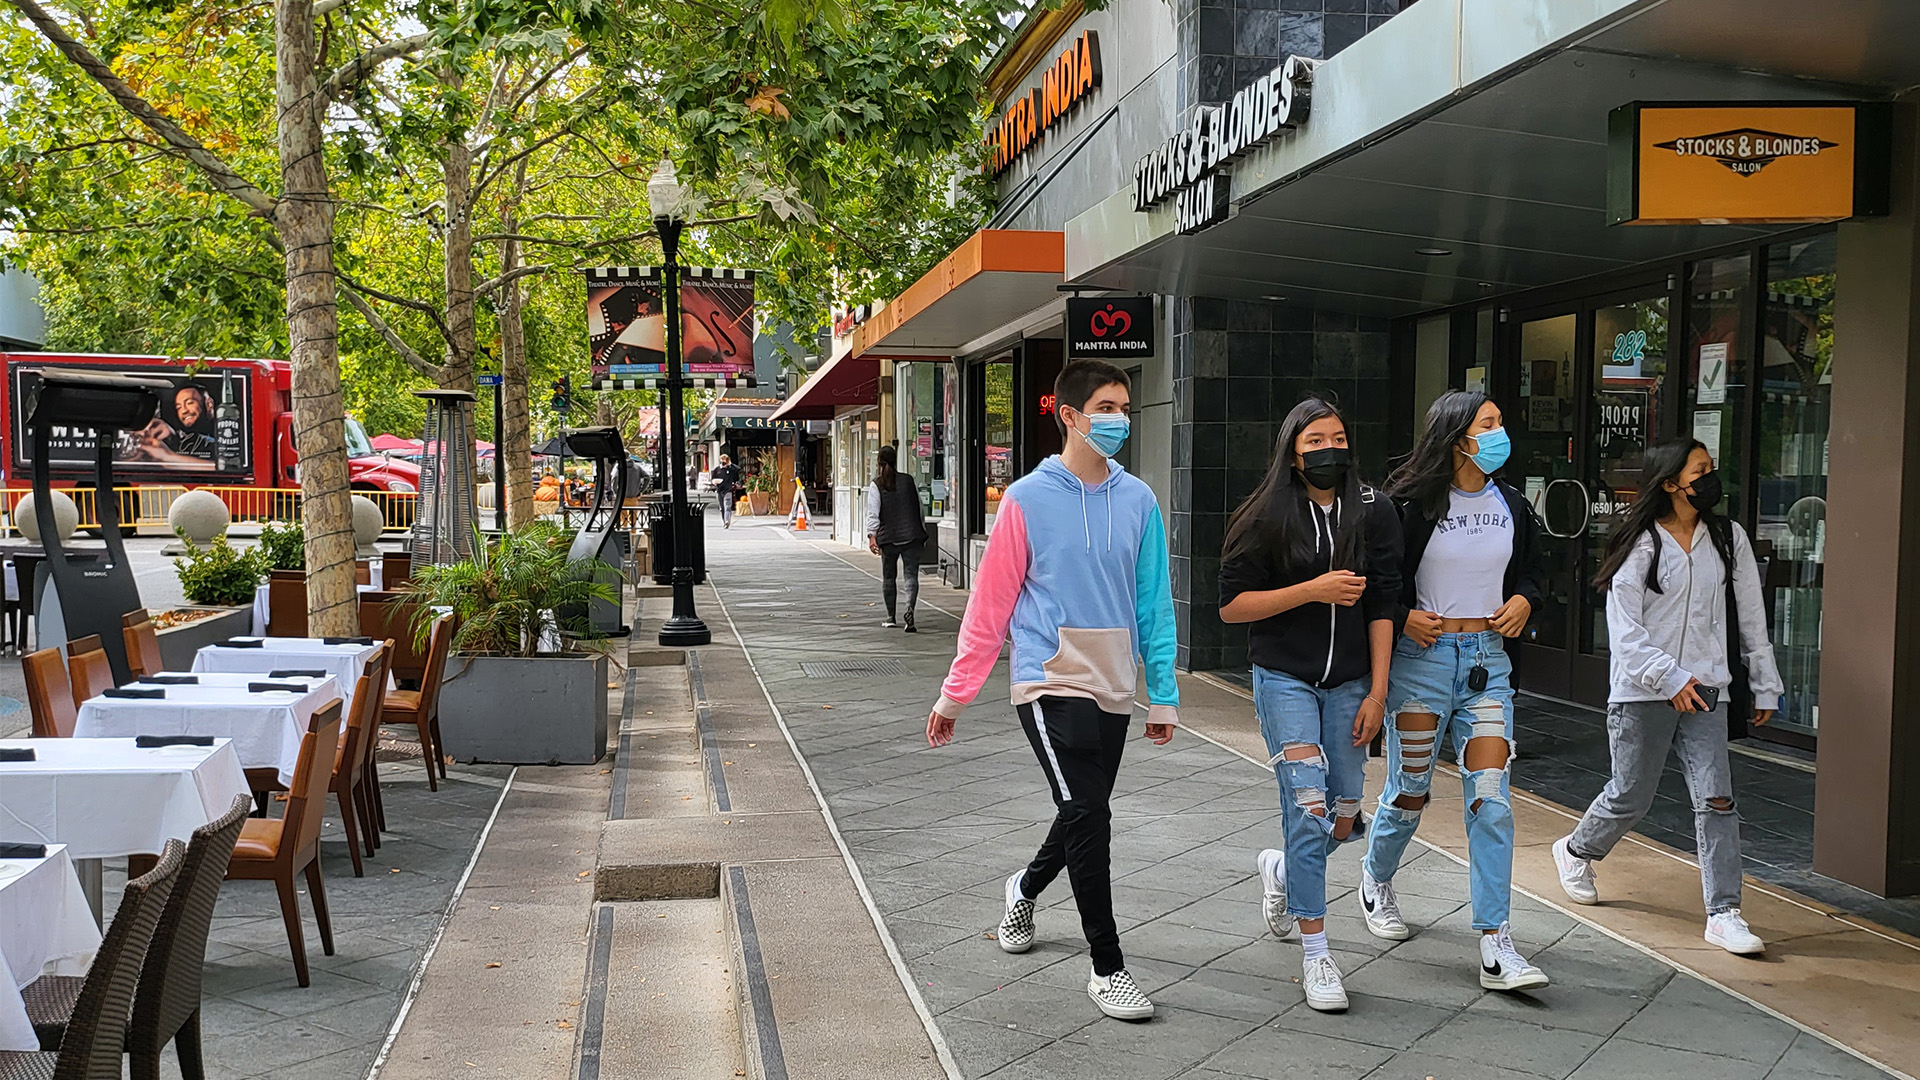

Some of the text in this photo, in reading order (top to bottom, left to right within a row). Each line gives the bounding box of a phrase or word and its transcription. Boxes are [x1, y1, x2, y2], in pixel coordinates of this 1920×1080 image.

[1042, 29, 1093, 131] INDIA
[1131, 54, 1294, 212] STOCKS & BLONDES
[1676, 135, 1820, 158] STOCKS & BLONDES
[1732, 162, 1761, 173] SALON
[1174, 174, 1215, 235] SALON
[1075, 341, 1147, 351] MANTRA INDIA
[1612, 330, 1647, 363] 282
[1040, 395, 1056, 408] OP
[75, 441, 121, 449] WHIY
[1591, 501, 1613, 516] (650)
[1437, 513, 1509, 534] NEW YORK
